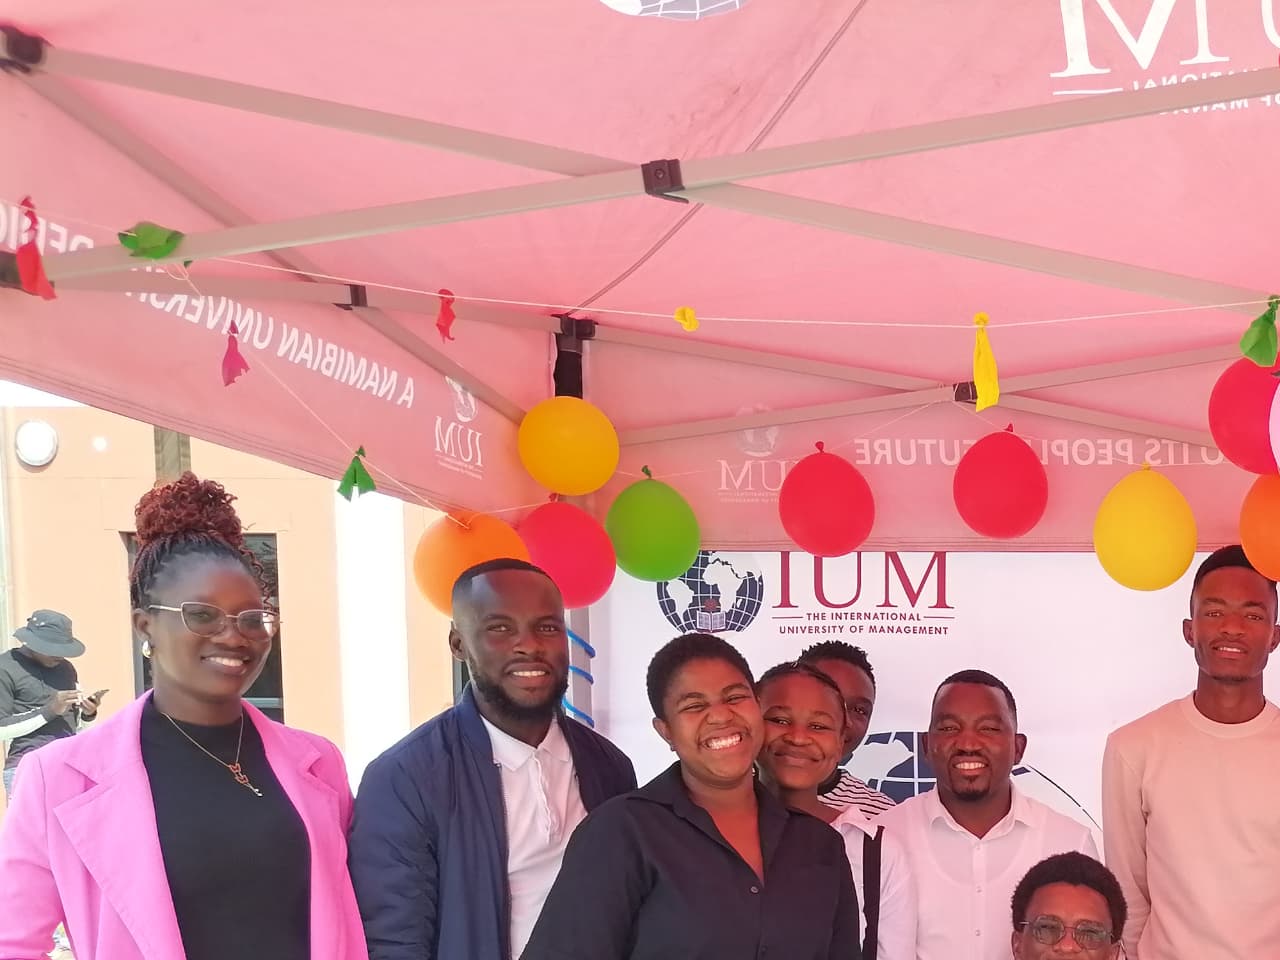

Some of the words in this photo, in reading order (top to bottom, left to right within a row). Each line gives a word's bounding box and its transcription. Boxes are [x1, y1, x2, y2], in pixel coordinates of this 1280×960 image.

[772, 551, 955, 609] IUM
[806, 612, 828, 622] THE
[830, 612, 922, 622] INTERNATIONAL
[779, 625, 845, 635] UNIVERSITY
[849, 625, 865, 635] OF
[868, 625, 949, 636] MANAGEMENT
